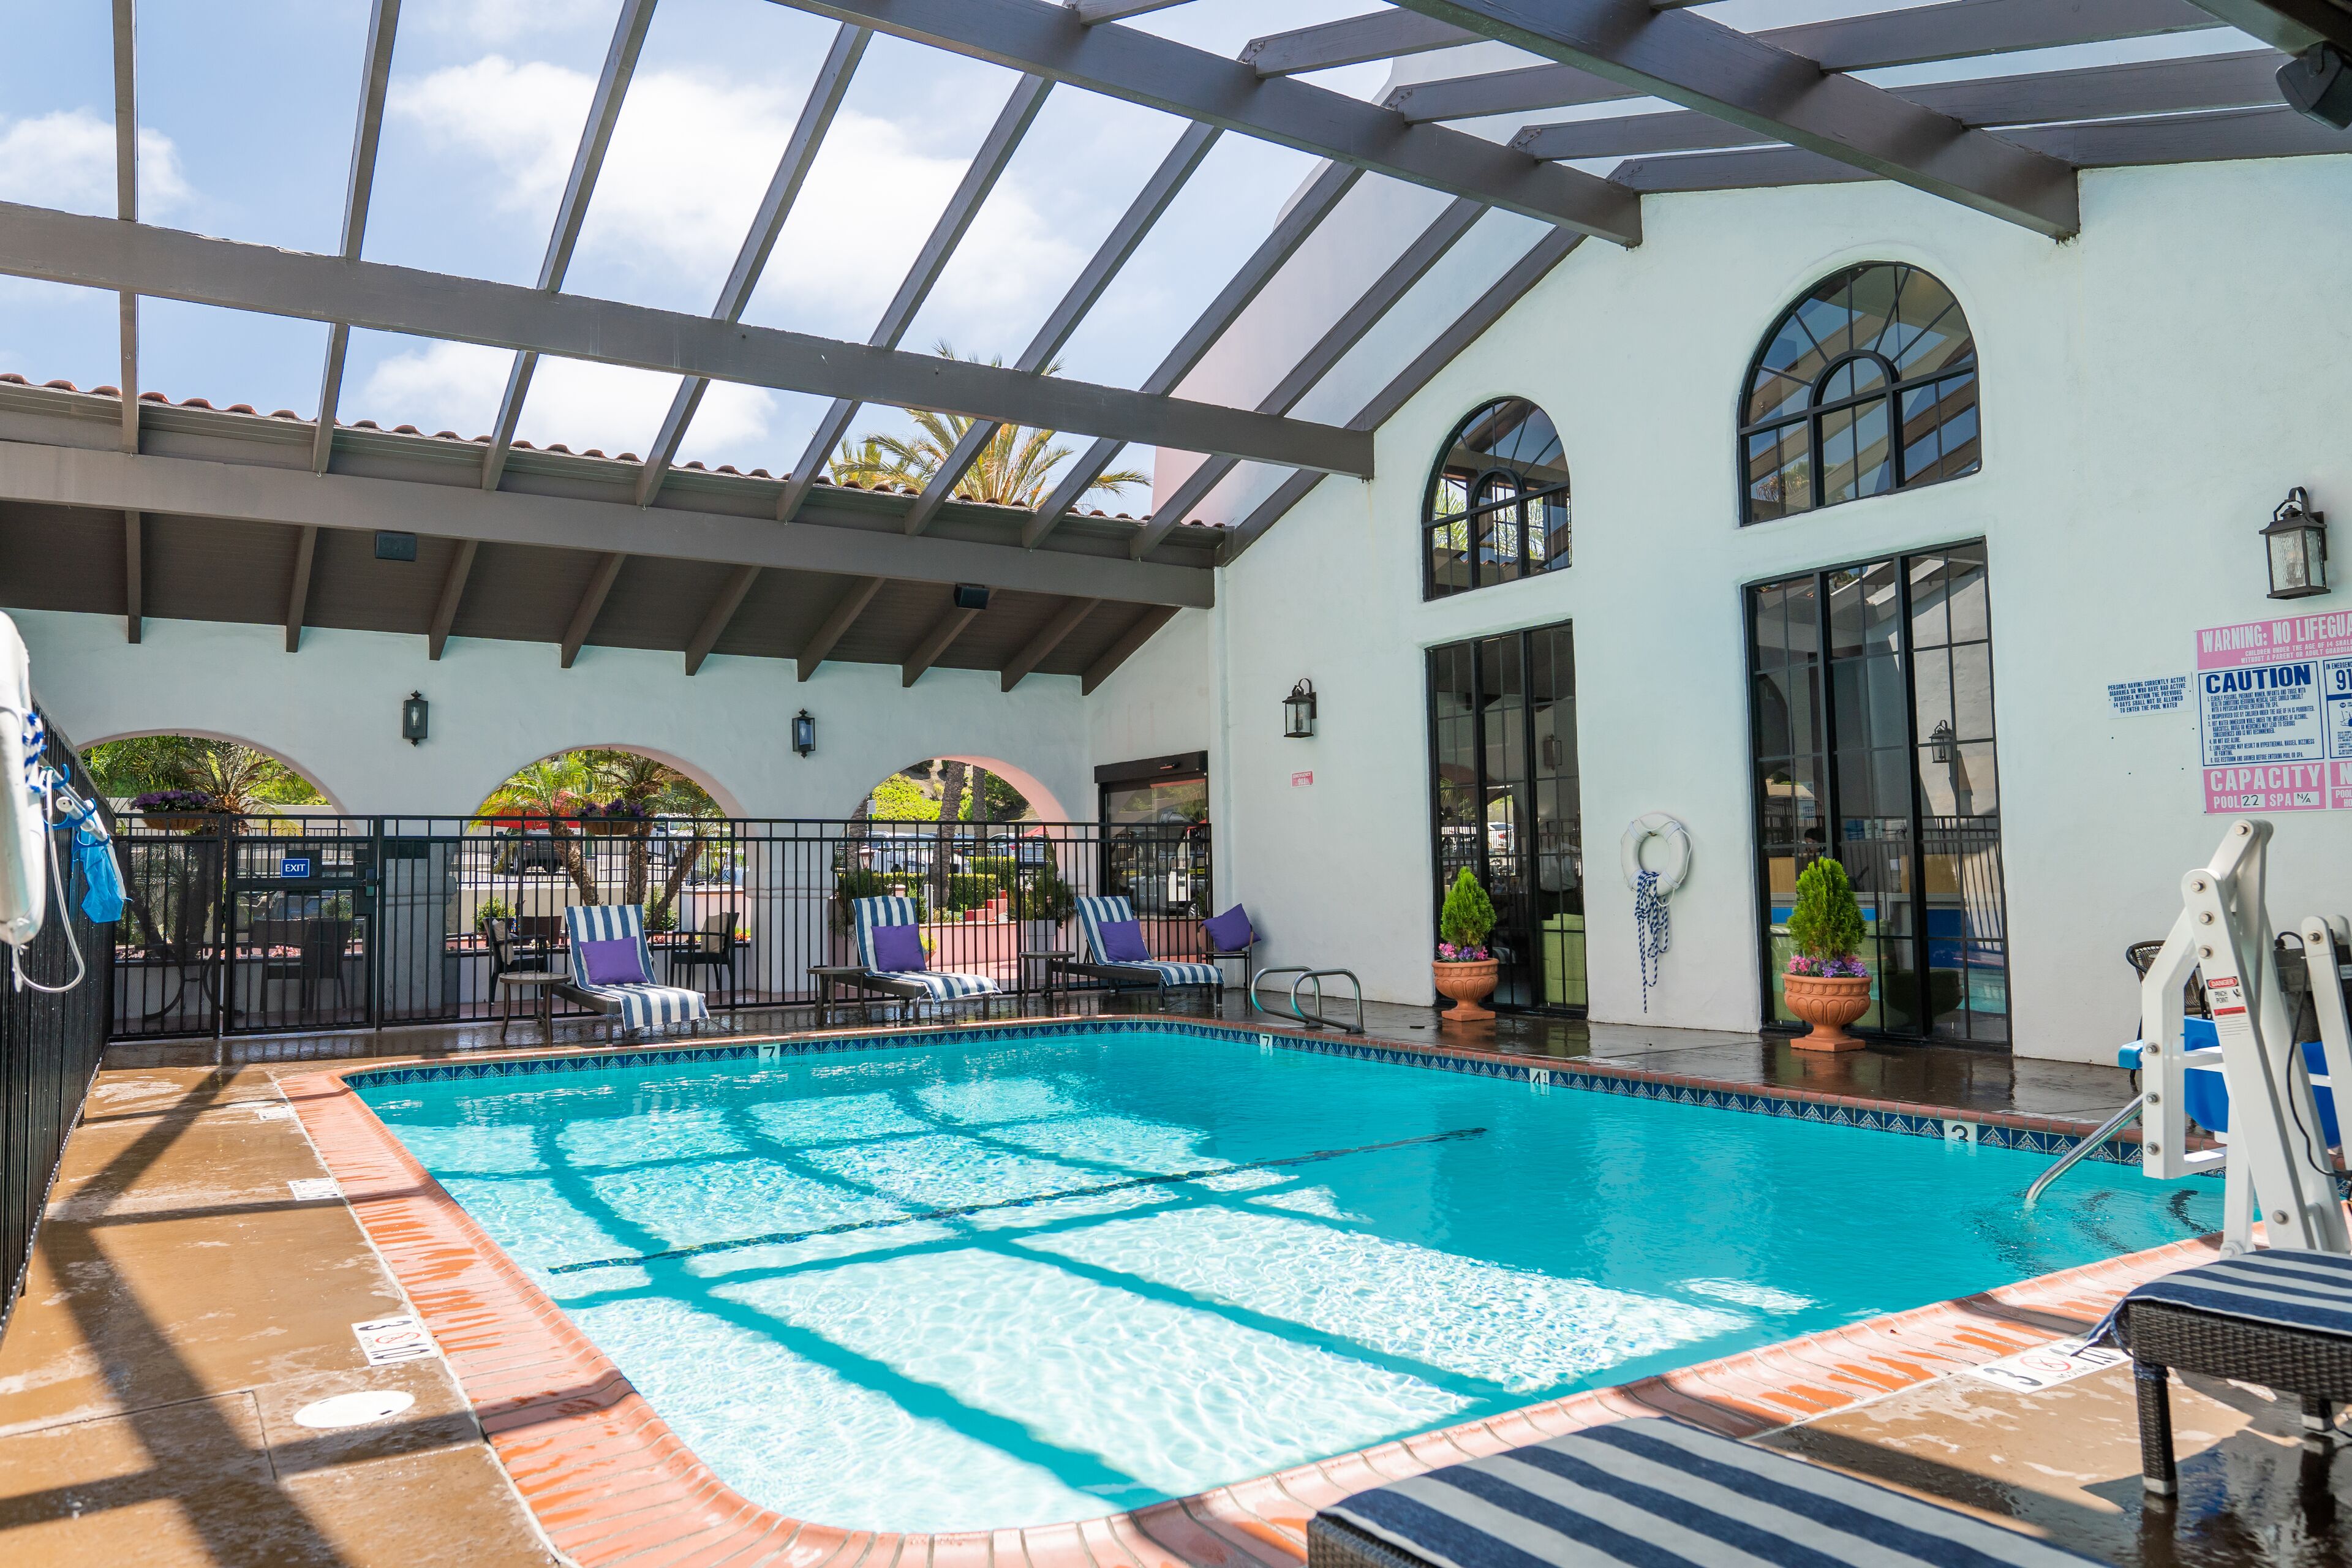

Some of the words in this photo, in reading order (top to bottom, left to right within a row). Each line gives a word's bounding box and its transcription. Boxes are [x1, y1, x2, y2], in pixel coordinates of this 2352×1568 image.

[2202, 625, 2267, 653] WARNING:
[2272, 621, 2291, 644] NO
[2245, 648, 2271, 657] CHILDREN
[2206, 665, 2312, 693] CAUTION
[2211, 765, 2321, 791] CAPACITY
[2214, 796, 2241, 809] POOL
[2242, 794, 2260, 805] 22
[2269, 793, 2291, 807] SPA
[2297, 793, 2311, 803] N/A
[1262, 1036, 1270, 1046] 7
[763, 1046, 775, 1058] 7
[1951, 1125, 1970, 1142] 3
[1983, 1368, 2043, 1386] 3
